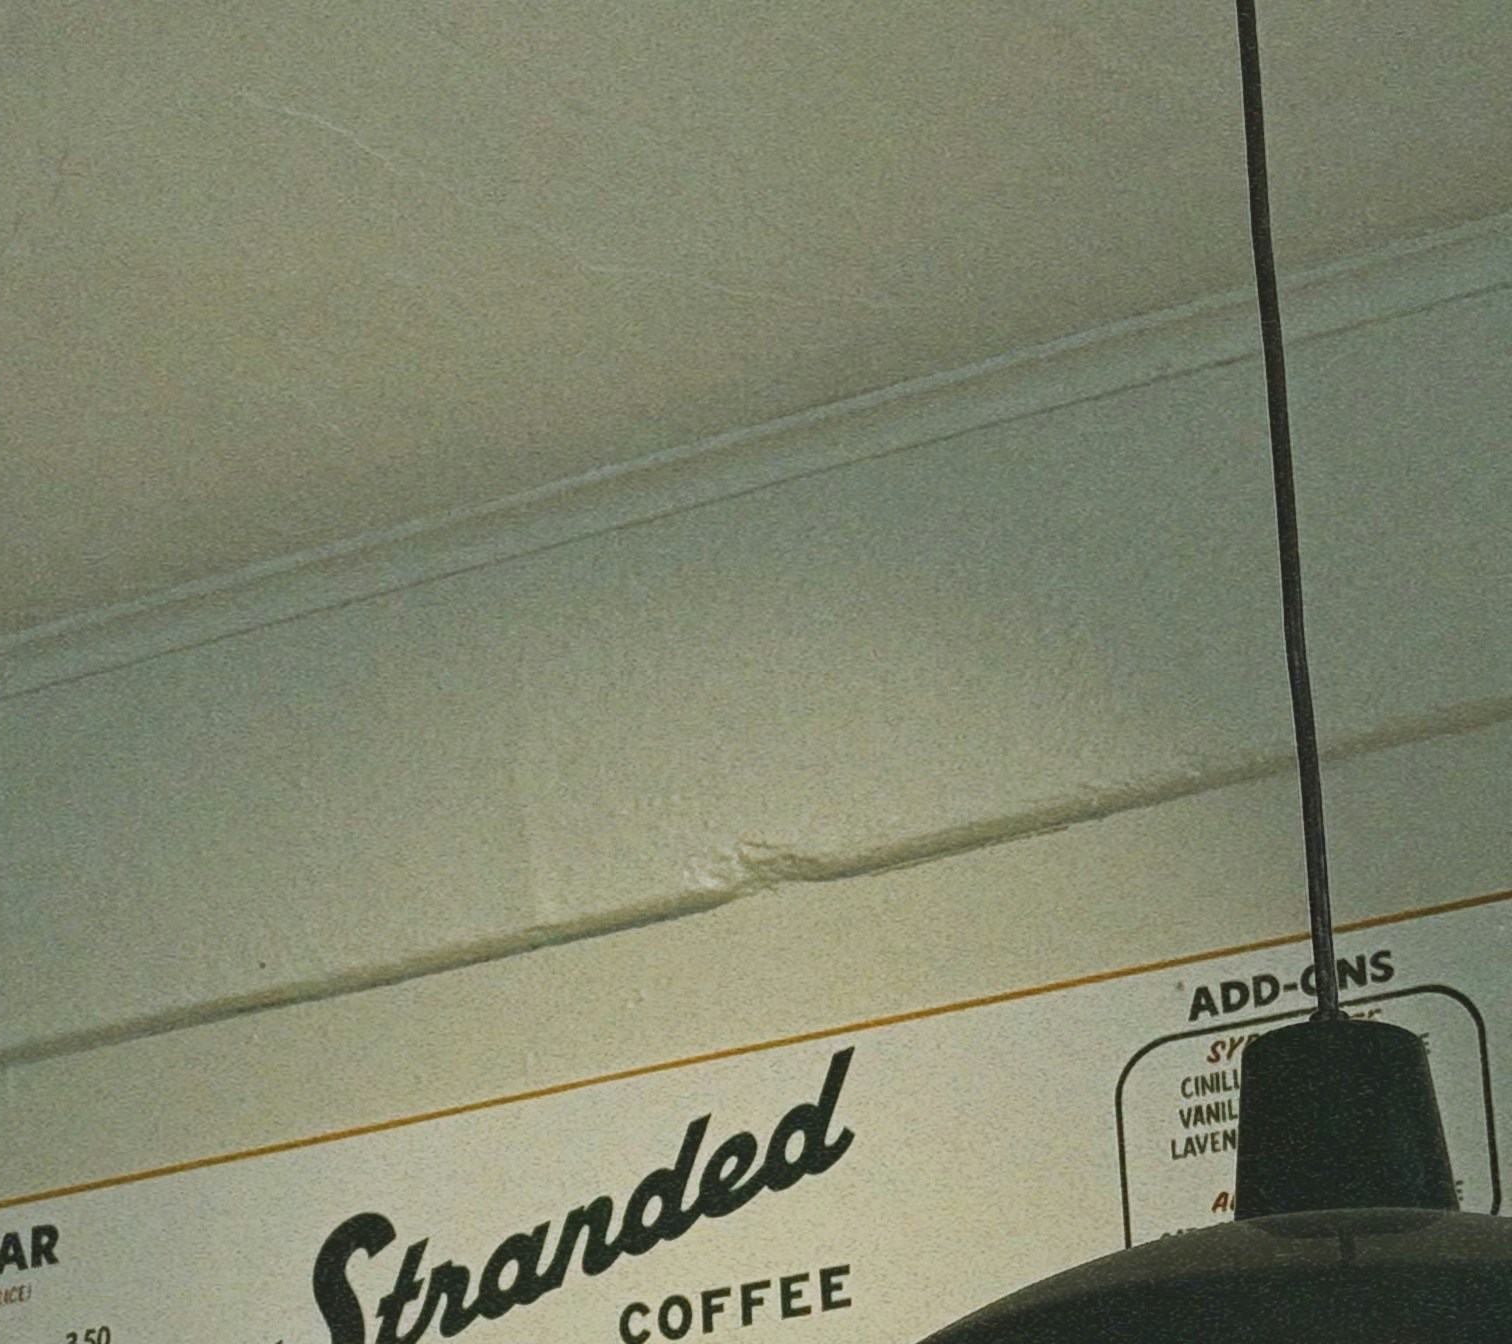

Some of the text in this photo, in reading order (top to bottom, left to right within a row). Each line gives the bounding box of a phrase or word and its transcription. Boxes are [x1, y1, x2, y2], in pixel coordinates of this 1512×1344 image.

[1206, 1033, 1259, 1064] SY
[1180, 1068, 1240, 1099] CINILL
[1178, 1098, 1239, 1130] VANIL
[1170, 1128, 1237, 1160] LAVEN
